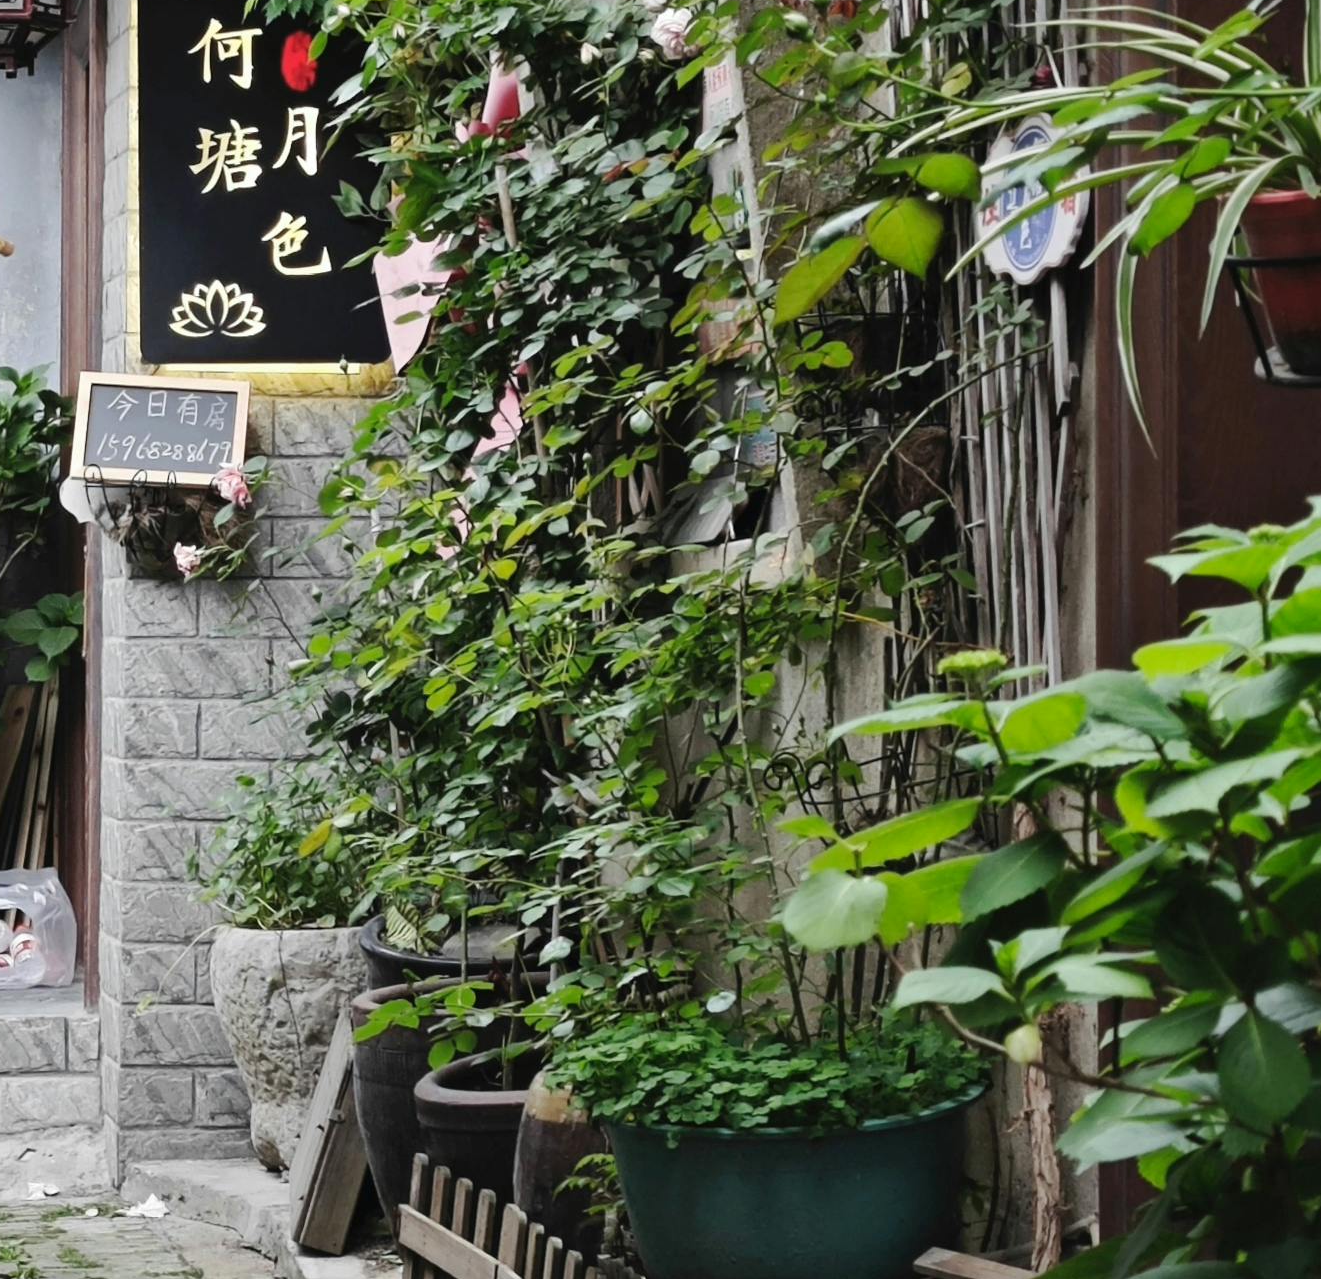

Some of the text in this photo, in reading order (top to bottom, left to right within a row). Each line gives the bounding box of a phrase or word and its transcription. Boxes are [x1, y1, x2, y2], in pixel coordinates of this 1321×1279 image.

[187, 17, 264, 195] 何塘
[260, 105, 333, 277] 月色
[107, 389, 229, 432] 今日有房
